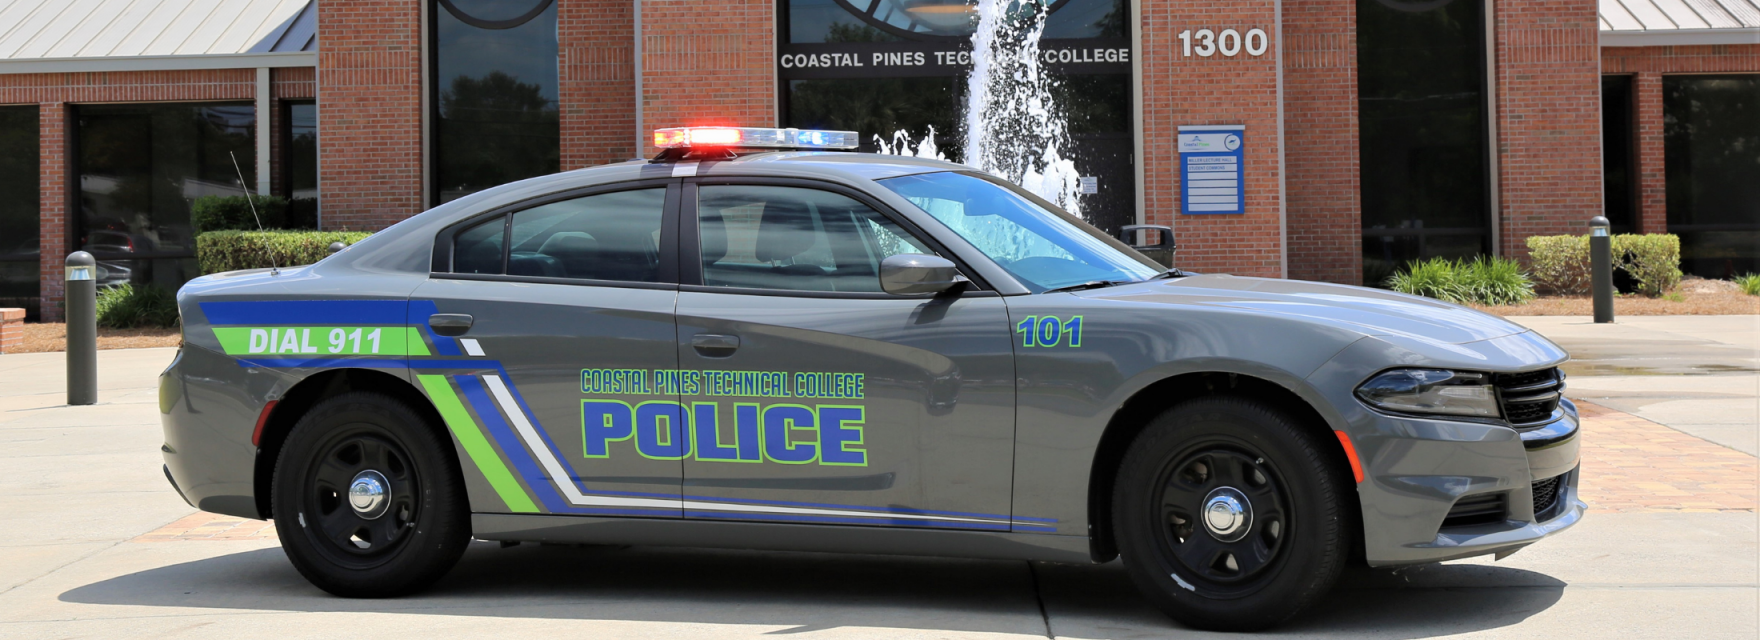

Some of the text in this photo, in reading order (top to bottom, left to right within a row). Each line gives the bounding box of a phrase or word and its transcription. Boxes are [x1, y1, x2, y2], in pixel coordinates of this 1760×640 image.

[1178, 28, 1268, 57] 1300
[780, 53, 864, 68] COASTAL
[872, 51, 926, 66] PINES
[1044, 49, 1129, 63] COLLEGE
[248, 328, 382, 353] DIAL 911
[1016, 315, 1084, 348] 101
[580, 368, 865, 399] COASTAL PINES TECHNICAL COLLEGE
[580, 398, 868, 467] POLICE
